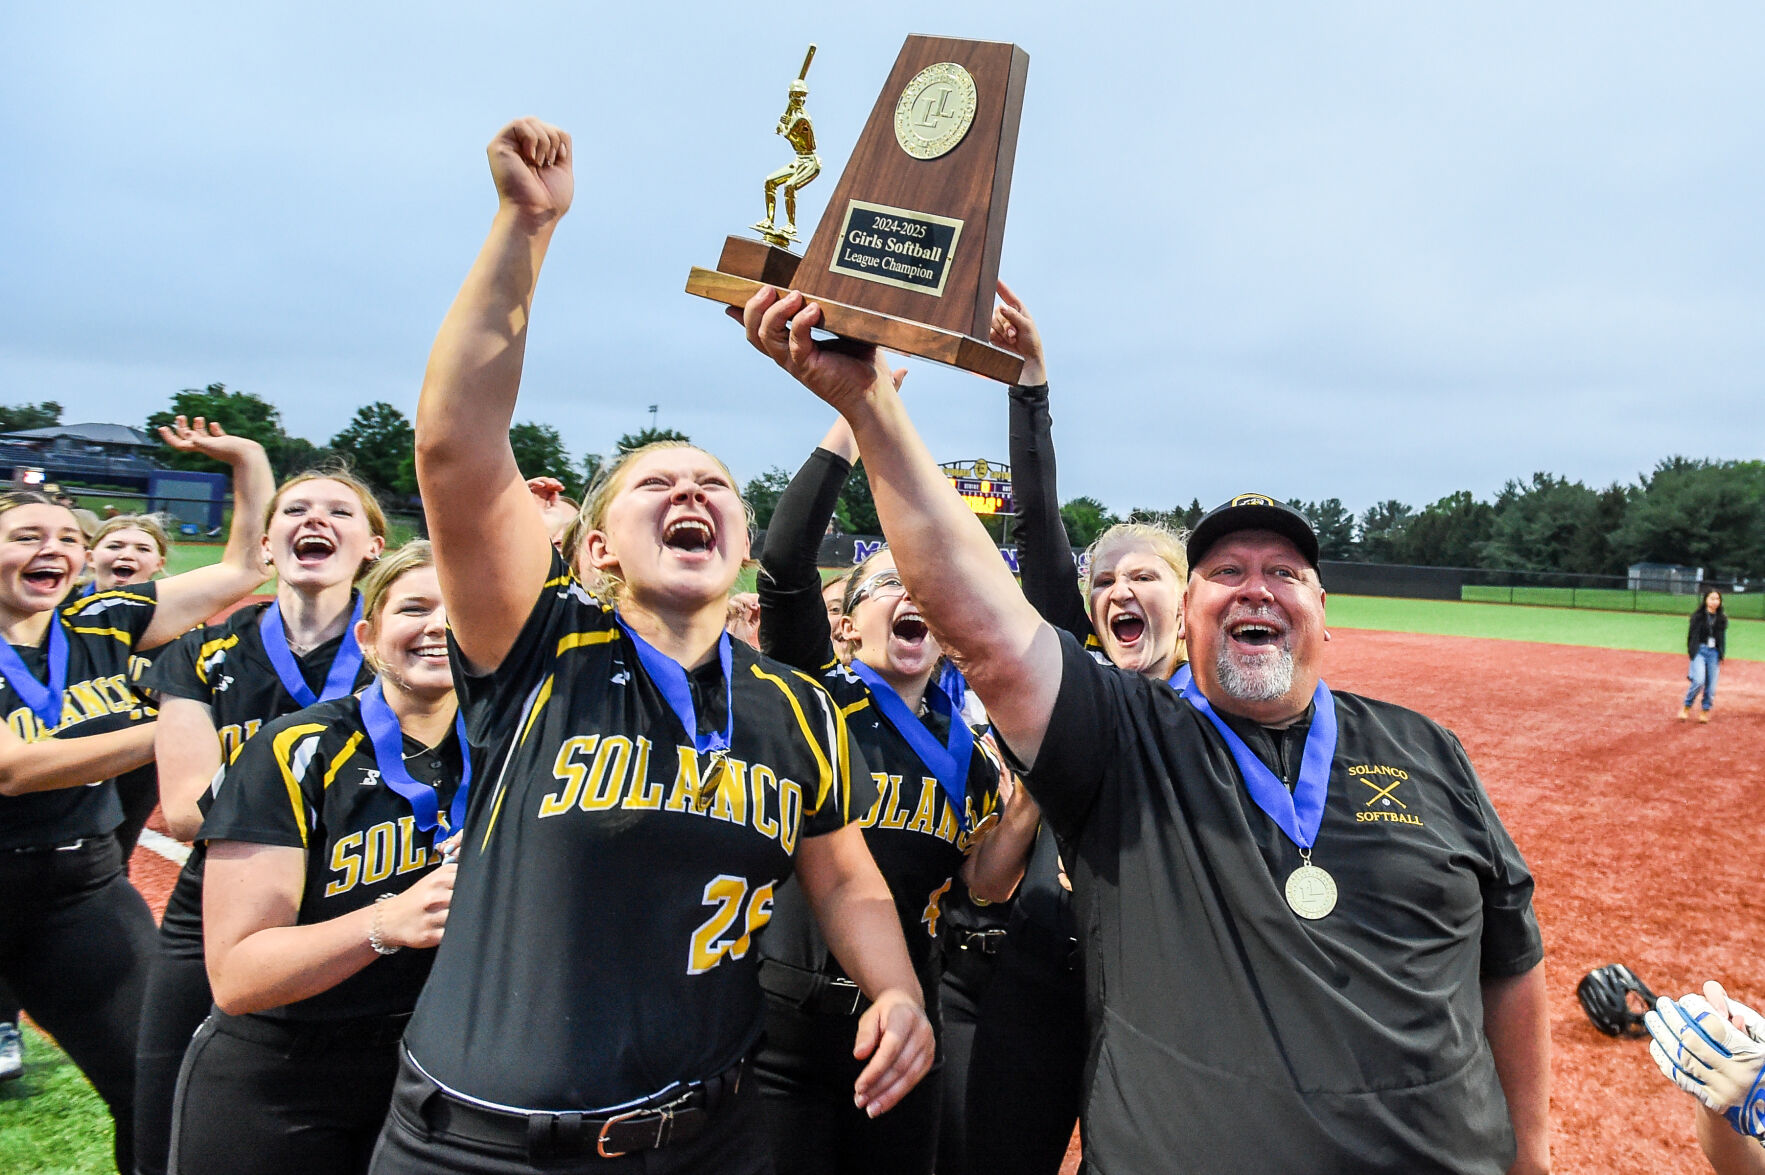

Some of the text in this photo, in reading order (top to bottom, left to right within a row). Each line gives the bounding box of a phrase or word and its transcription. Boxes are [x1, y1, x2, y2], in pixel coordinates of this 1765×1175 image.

[872, 216, 928, 238] 2024-2025
[848, 230, 942, 262] Girls Softball
[844, 248, 934, 280] League Champion
[1348, 764, 1409, 780] SOLANCO
[538, 734, 803, 856] SOLANCO
[1356, 811, 1424, 826] SOFTBALL
